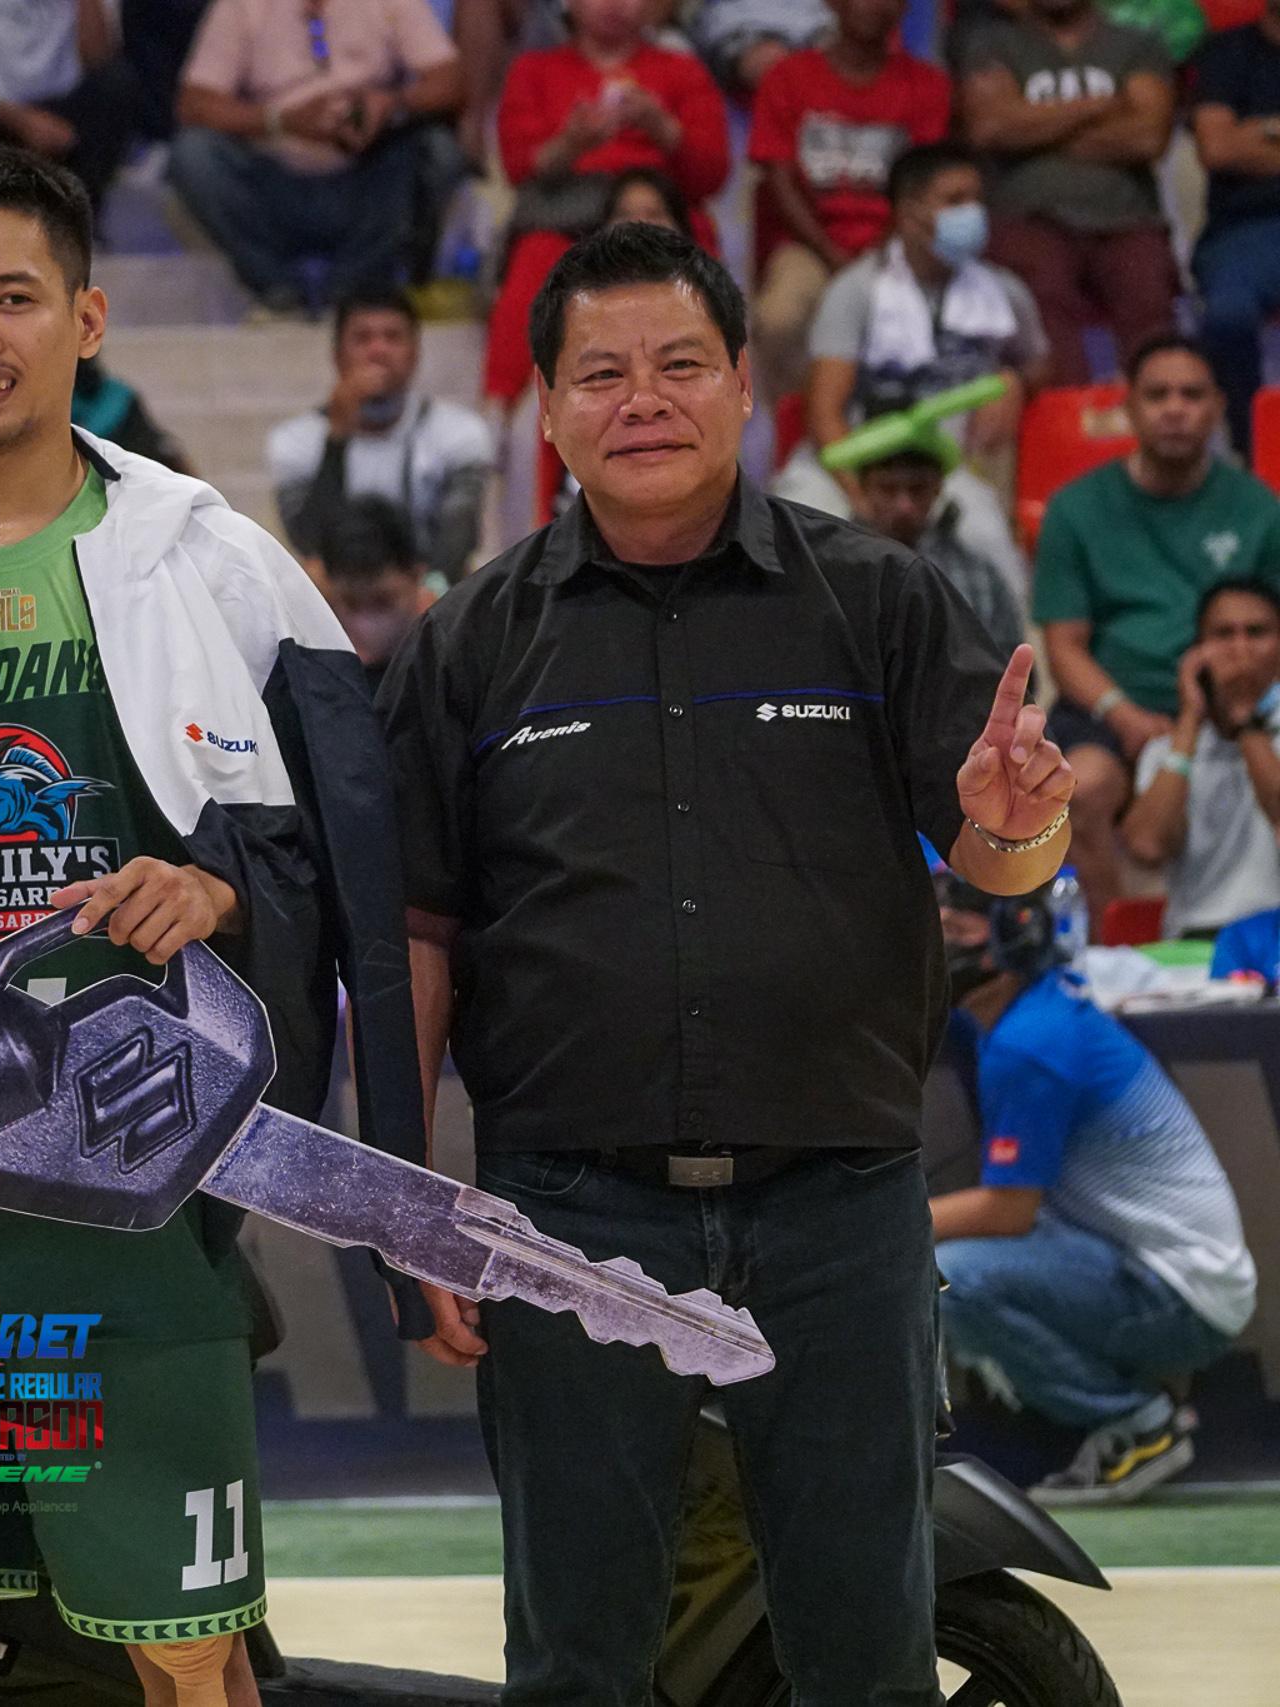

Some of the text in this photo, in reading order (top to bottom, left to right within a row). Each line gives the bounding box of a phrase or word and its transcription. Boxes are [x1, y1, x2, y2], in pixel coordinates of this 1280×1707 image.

[781, 704, 851, 720] SUZUKI
[501, 721, 592, 750] Avenis
[182, 1479, 249, 1592] 11
